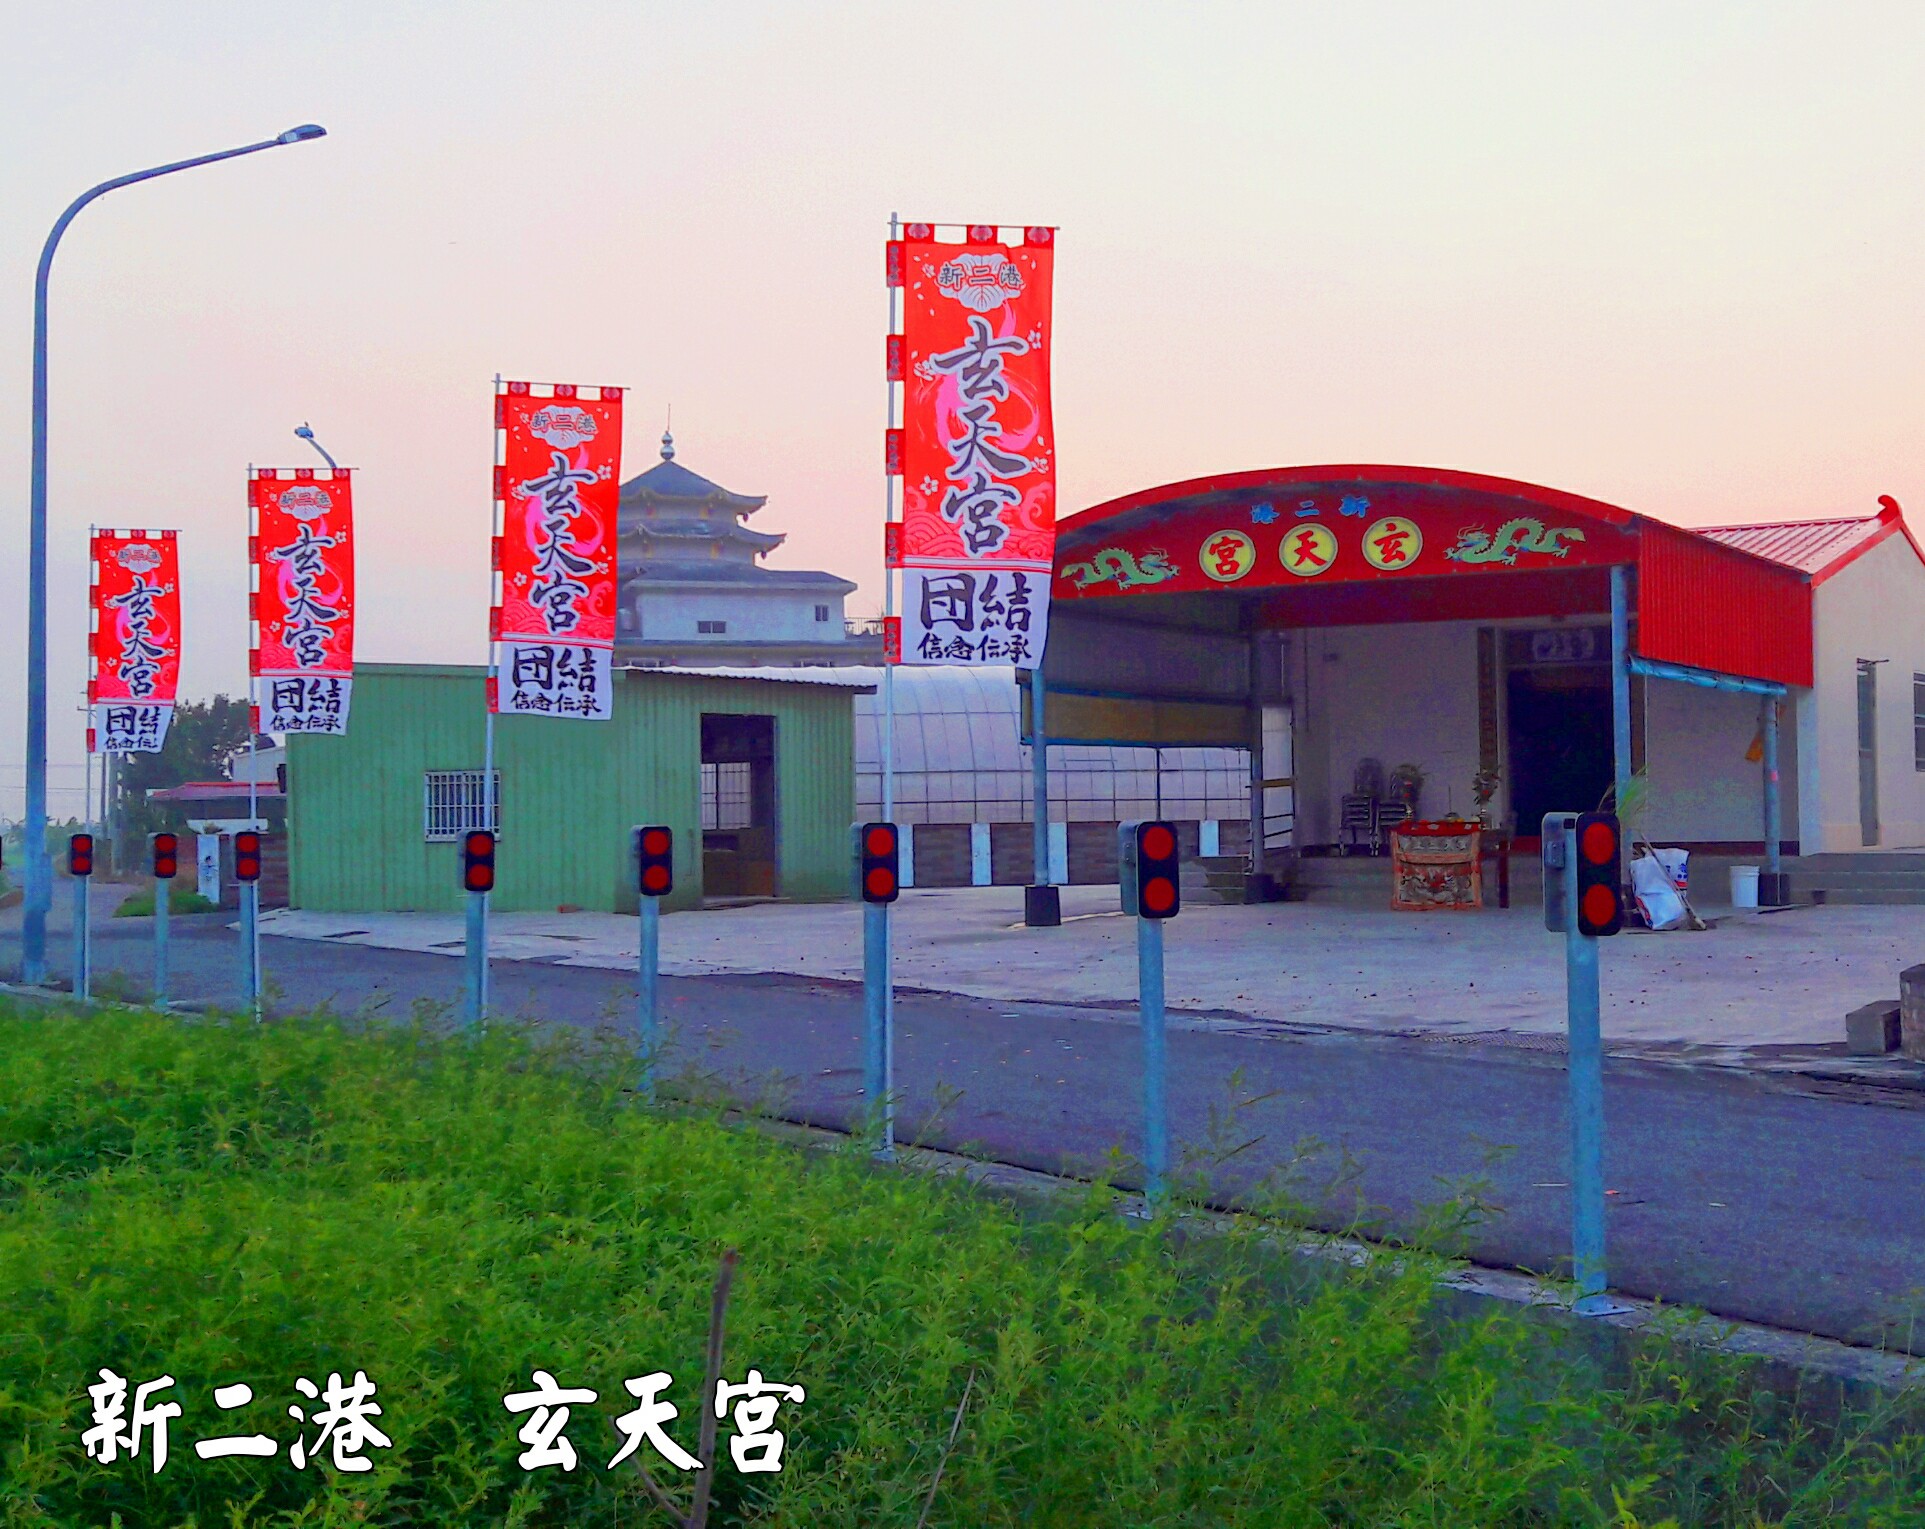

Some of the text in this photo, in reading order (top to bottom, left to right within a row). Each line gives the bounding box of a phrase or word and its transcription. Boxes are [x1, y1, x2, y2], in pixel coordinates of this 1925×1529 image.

[939, 264, 1022, 289] 新二港
[934, 319, 1028, 554] 玄天宮
[276, 525, 337, 667] 玄天宮
[525, 454, 594, 632] 玄天宮
[116, 577, 164, 697] 玄天宮
